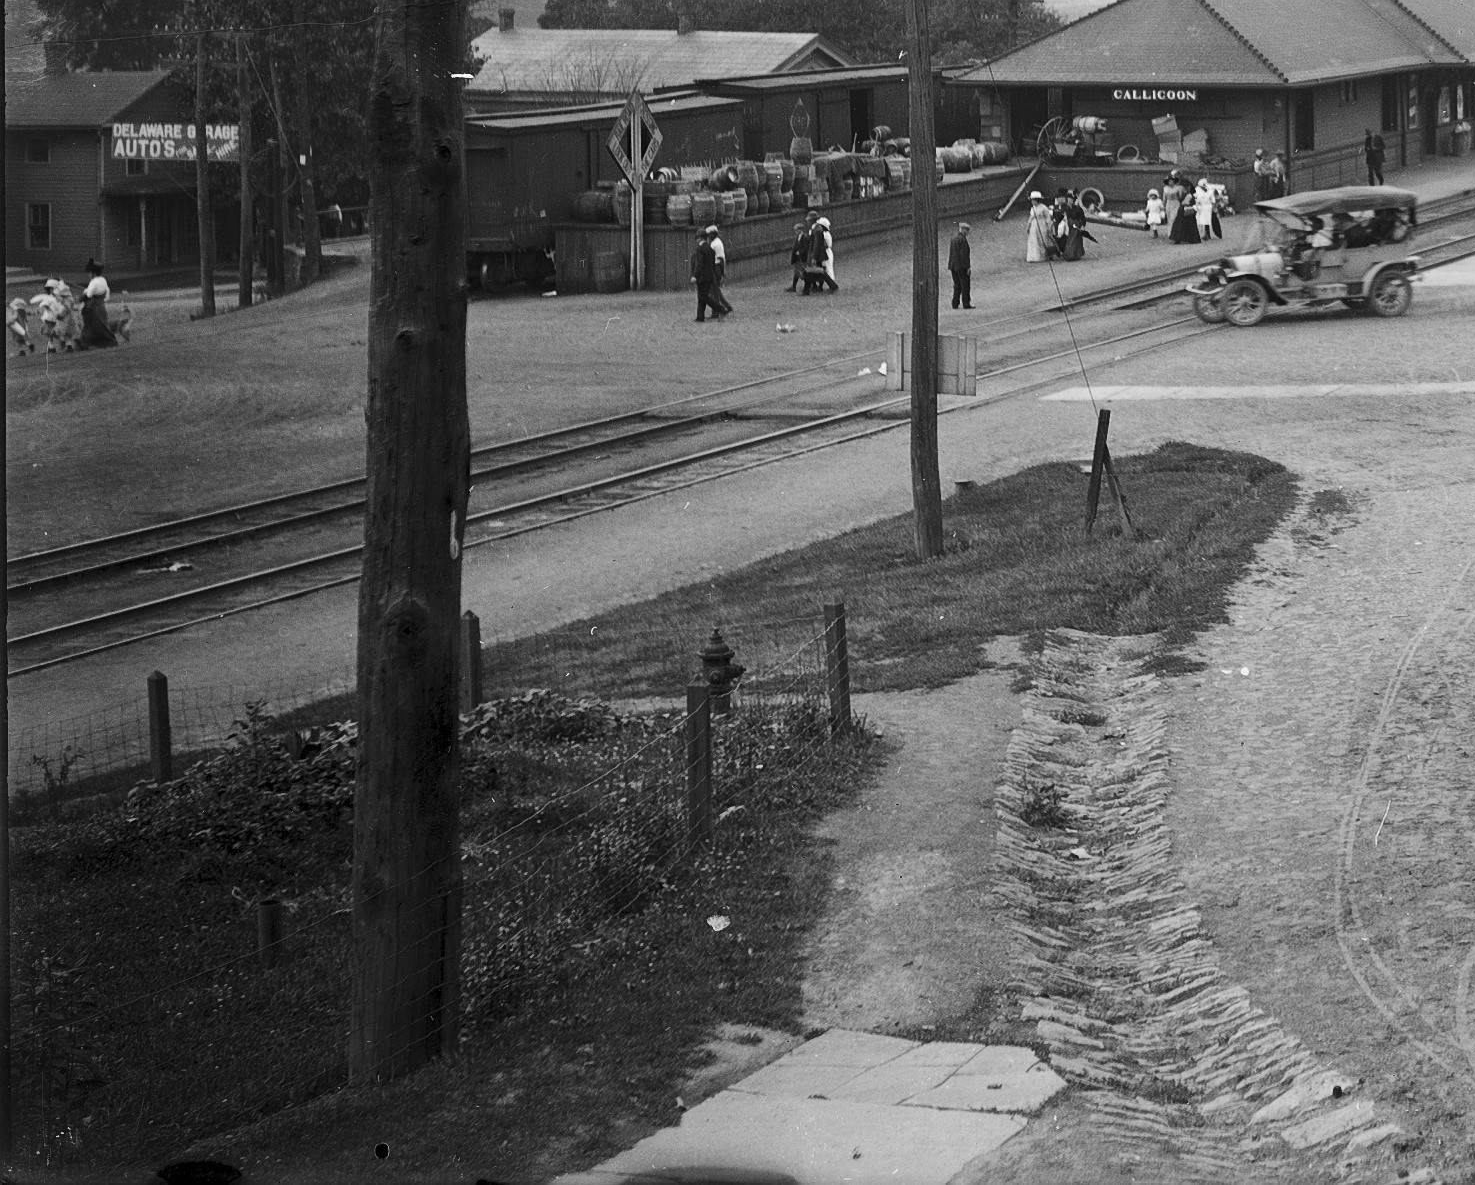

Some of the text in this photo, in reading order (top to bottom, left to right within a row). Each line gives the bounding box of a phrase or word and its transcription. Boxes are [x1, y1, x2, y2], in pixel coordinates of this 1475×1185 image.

[1113, 89, 1196, 101] CALLICOON
[112, 123, 239, 140] DELAWARE GRAGE
[114, 138, 175, 158] AUTO'S
